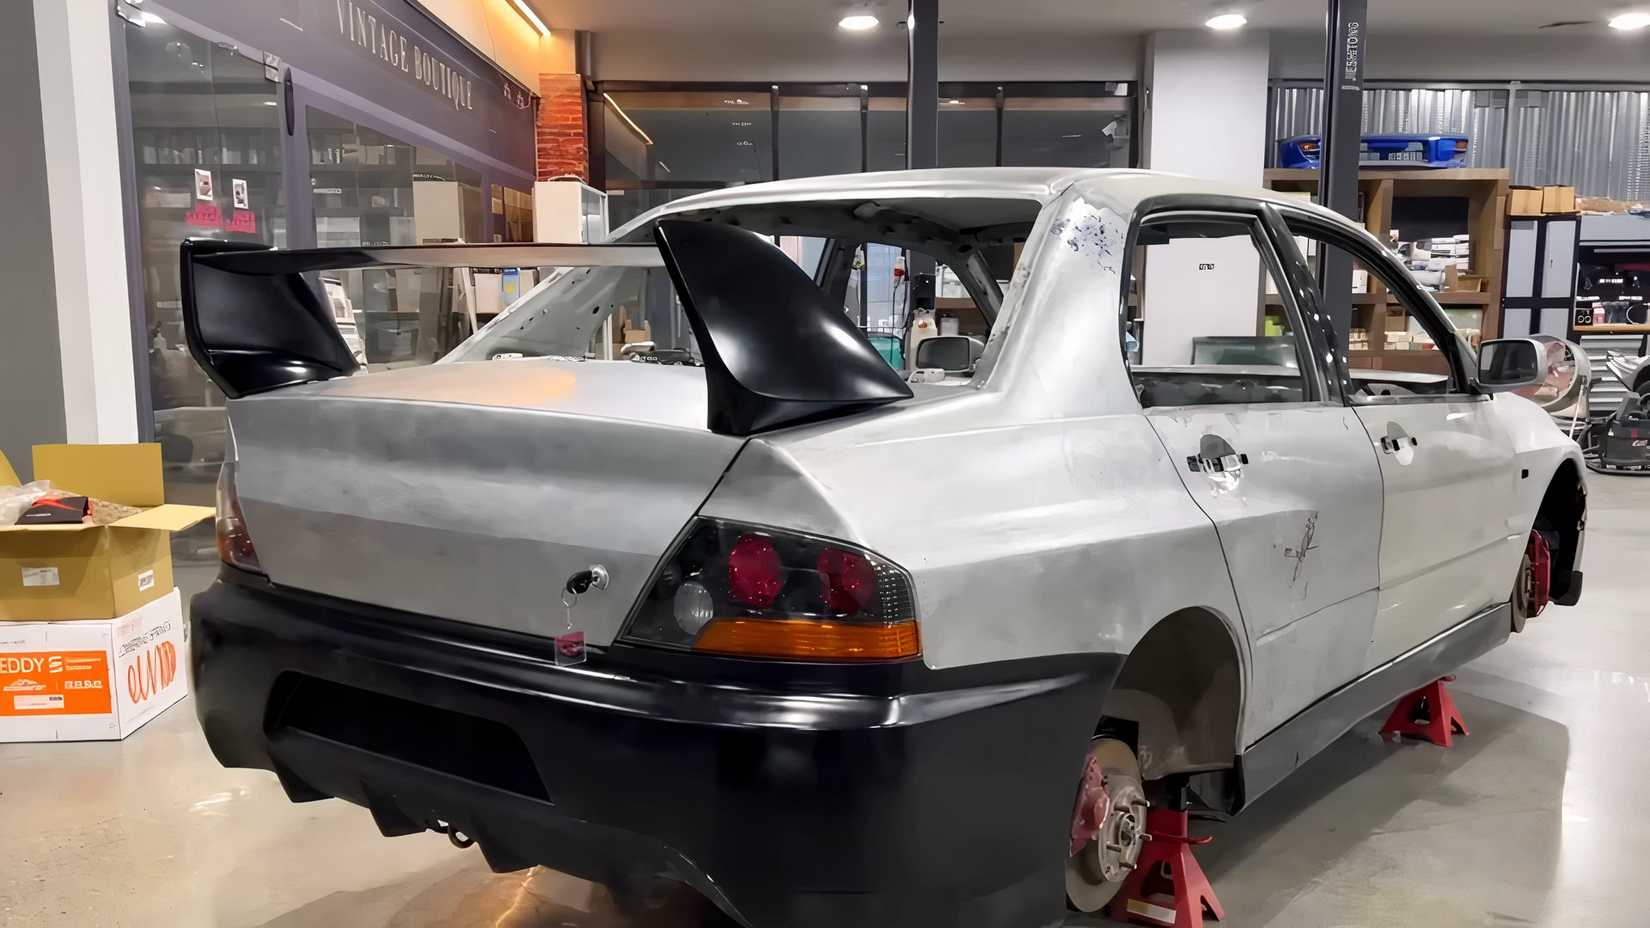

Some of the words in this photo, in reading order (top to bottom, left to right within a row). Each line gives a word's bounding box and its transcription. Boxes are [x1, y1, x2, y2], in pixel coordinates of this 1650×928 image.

[336, 0, 408, 73] VINTAGE
[414, 45, 472, 111] BOUTIQUE
[0, 657, 44, 673] EDDY
